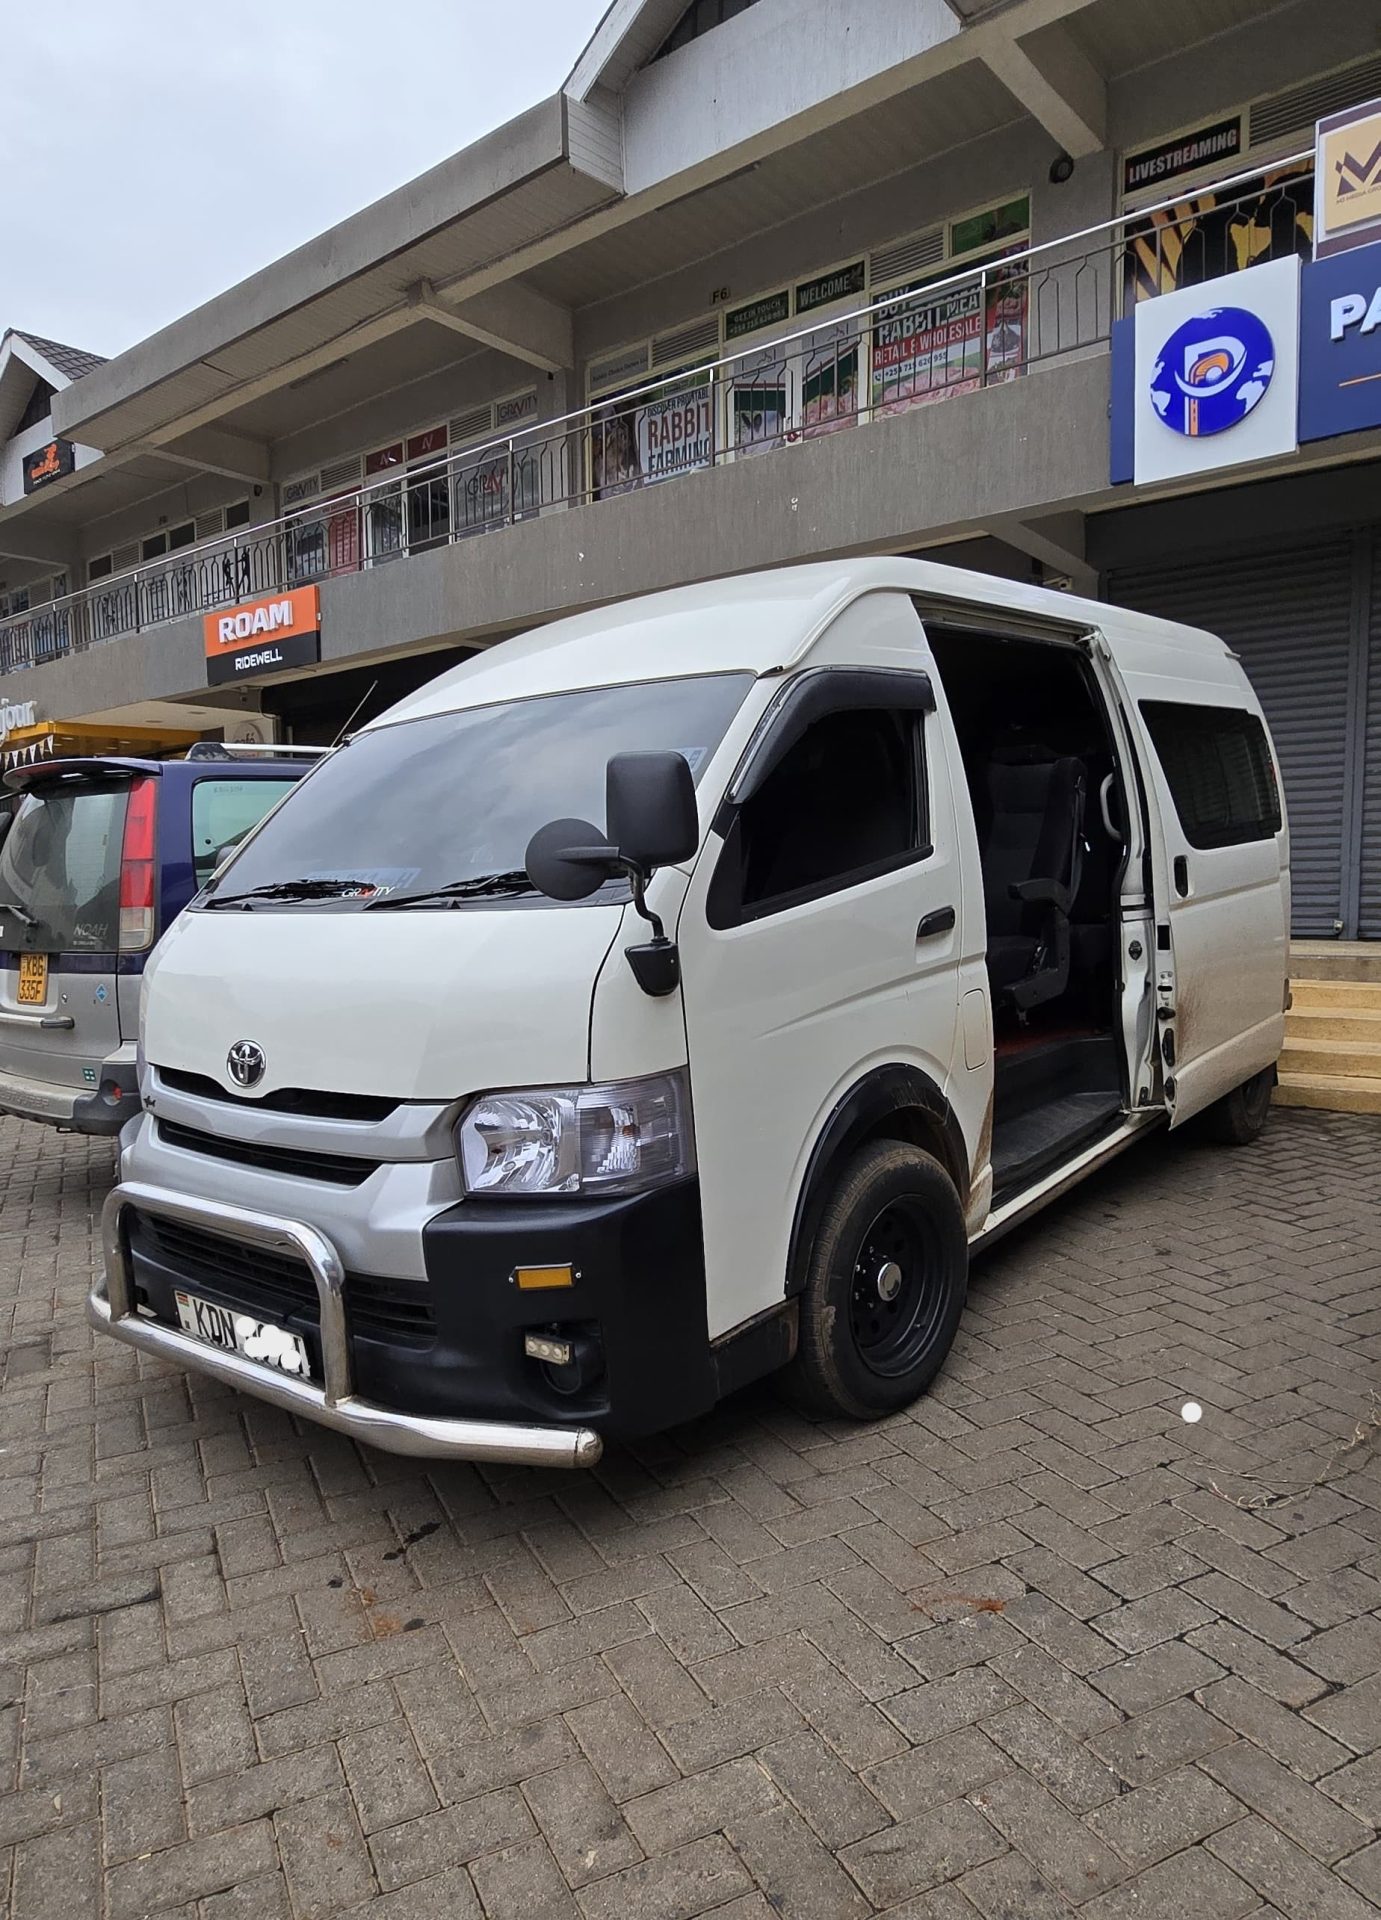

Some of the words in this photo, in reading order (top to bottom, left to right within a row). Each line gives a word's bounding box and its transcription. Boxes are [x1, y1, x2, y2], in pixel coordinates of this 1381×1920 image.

[1129, 129, 1237, 184] LIVESTREAMING
[712, 287, 727, 305] F6
[800, 275, 850, 307] WELCOME
[500, 395, 538, 419] GRAVITY
[286, 477, 318, 500] GRAVITY
[218, 600, 293, 643] ROAM
[235, 648, 283, 671] RIDEWELL
[341, 886, 396, 898] GRAVITY
[73, 922, 108, 937] NOAH
[26, 955, 44, 977] KBG
[19, 979, 43, 1000] 335F
[192, 1298, 238, 1350] KDN
